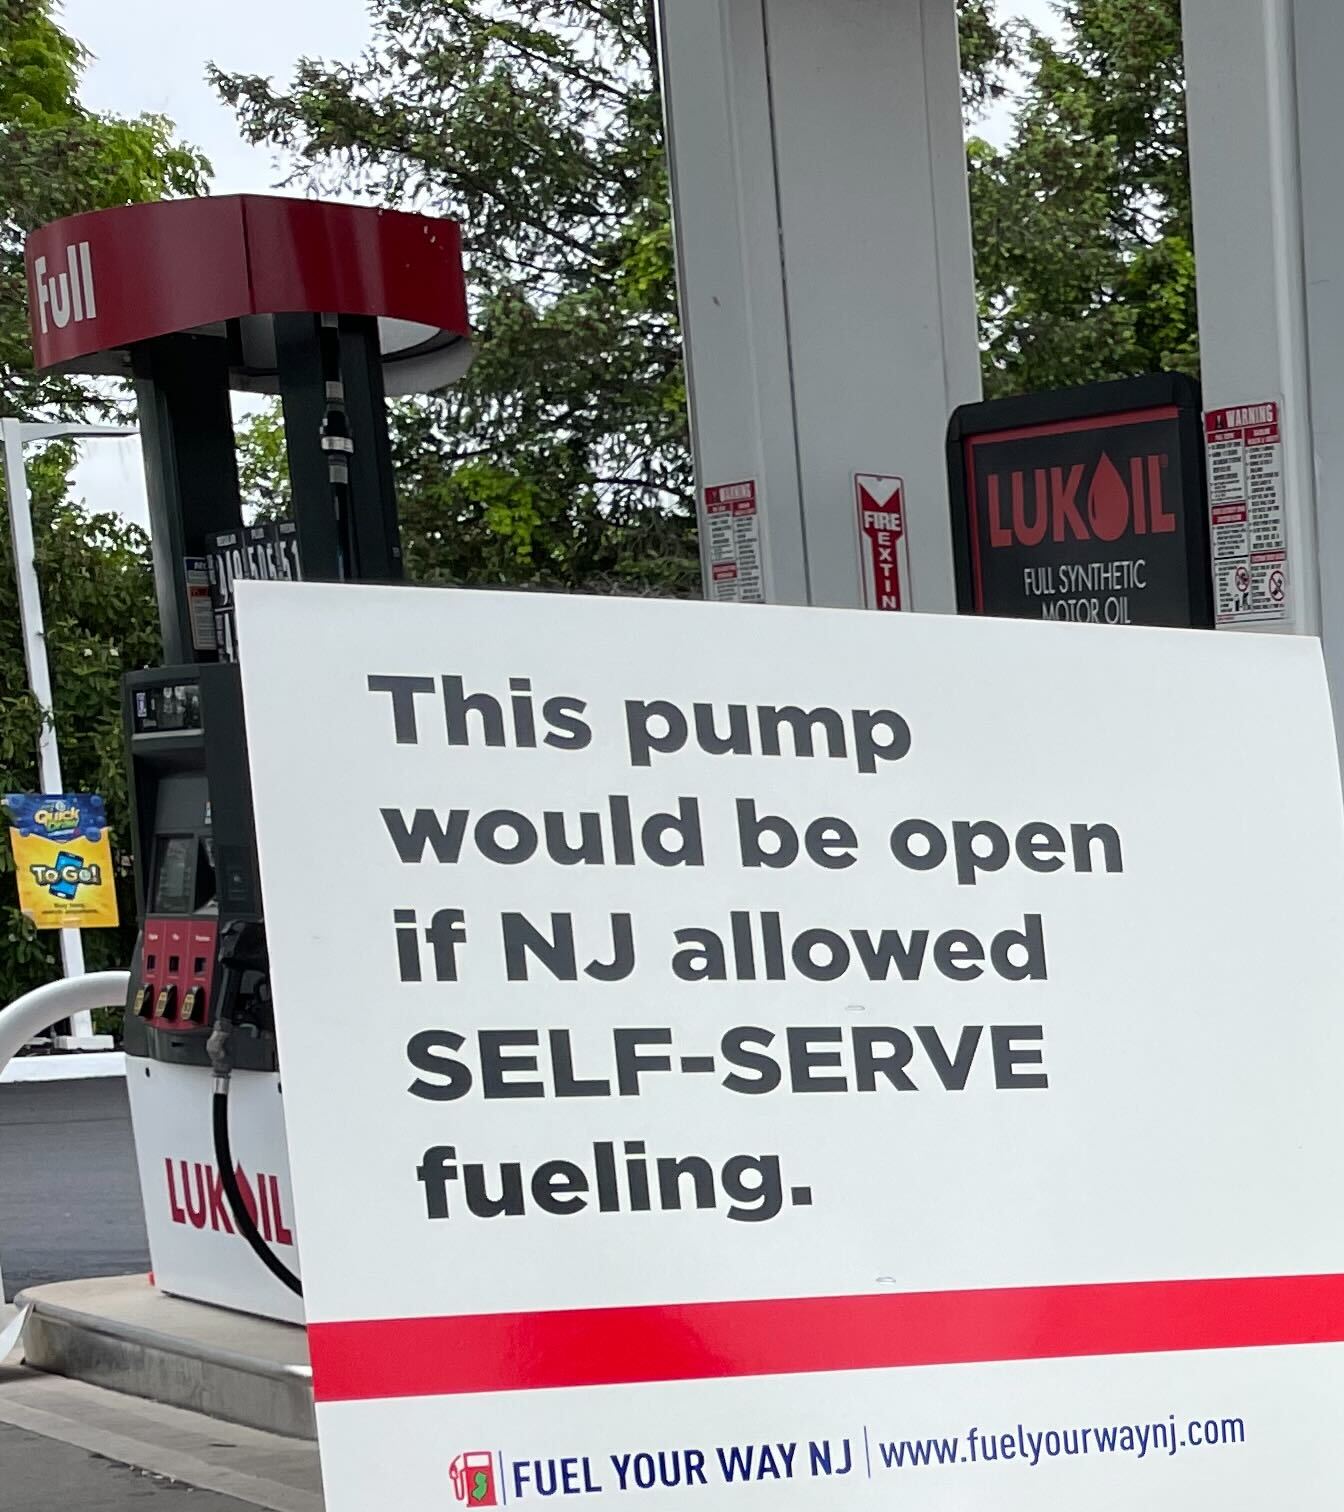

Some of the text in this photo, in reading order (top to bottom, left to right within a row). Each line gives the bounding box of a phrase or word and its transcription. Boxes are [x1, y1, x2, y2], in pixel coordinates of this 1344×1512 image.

[34, 241, 97, 335] Full
[1226, 403, 1274, 428] WARNING
[863, 511, 901, 532] FIRE
[987, 451, 1177, 548] LUKOIL
[1023, 559, 1147, 596] FULL SYNTHETIC
[1042, 596, 1132, 624] MOTOR OIL
[366, 673, 912, 775] This pump
[34, 806, 80, 824] Quick
[379, 794, 1124, 886] would be open
[31, 864, 98, 882] To Go!
[393, 908, 1049, 984] if NJ allowed
[405, 1023, 1050, 1102] SELF-SERVE
[416, 1138, 814, 1223] fueling.
[512, 1413, 1247, 1499] FUEL YOUR WAY NJ www.fuelyourwaynj.com
